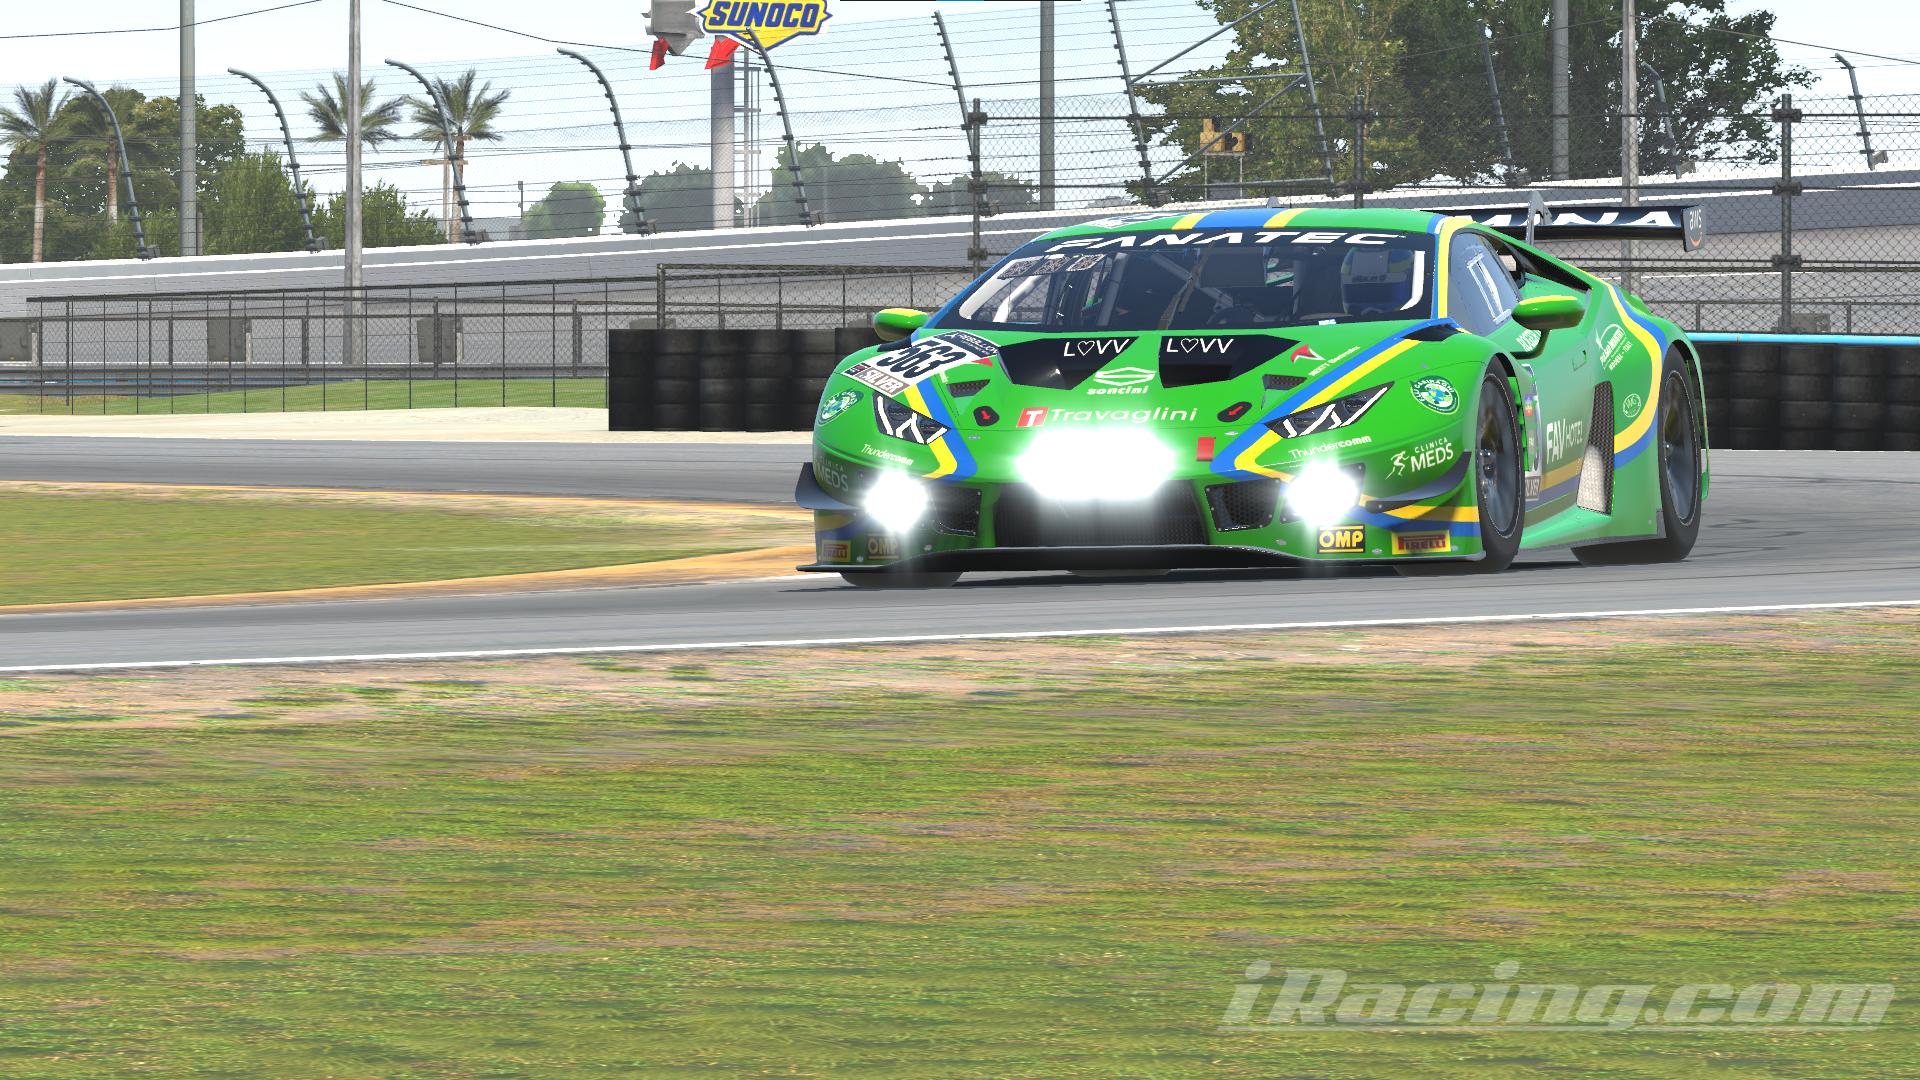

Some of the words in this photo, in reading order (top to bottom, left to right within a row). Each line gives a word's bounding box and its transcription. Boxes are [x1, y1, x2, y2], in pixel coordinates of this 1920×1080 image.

[708, 1, 820, 28] SUNOCO
[1045, 231, 1400, 252] FANATEC
[876, 339, 967, 379] 563
[859, 369, 904, 393] SILVER
[1050, 406, 1198, 424] Travaglini
[1288, 435, 1372, 460] Thundercomm
[1414, 437, 1448, 454] CLINICA
[1546, 418, 1566, 465] FAV
[1566, 420, 1583, 447] HOTEL
[1411, 442, 1454, 473] MEDS
[868, 535, 899, 554] OMP
[1319, 530, 1364, 549] OMP
